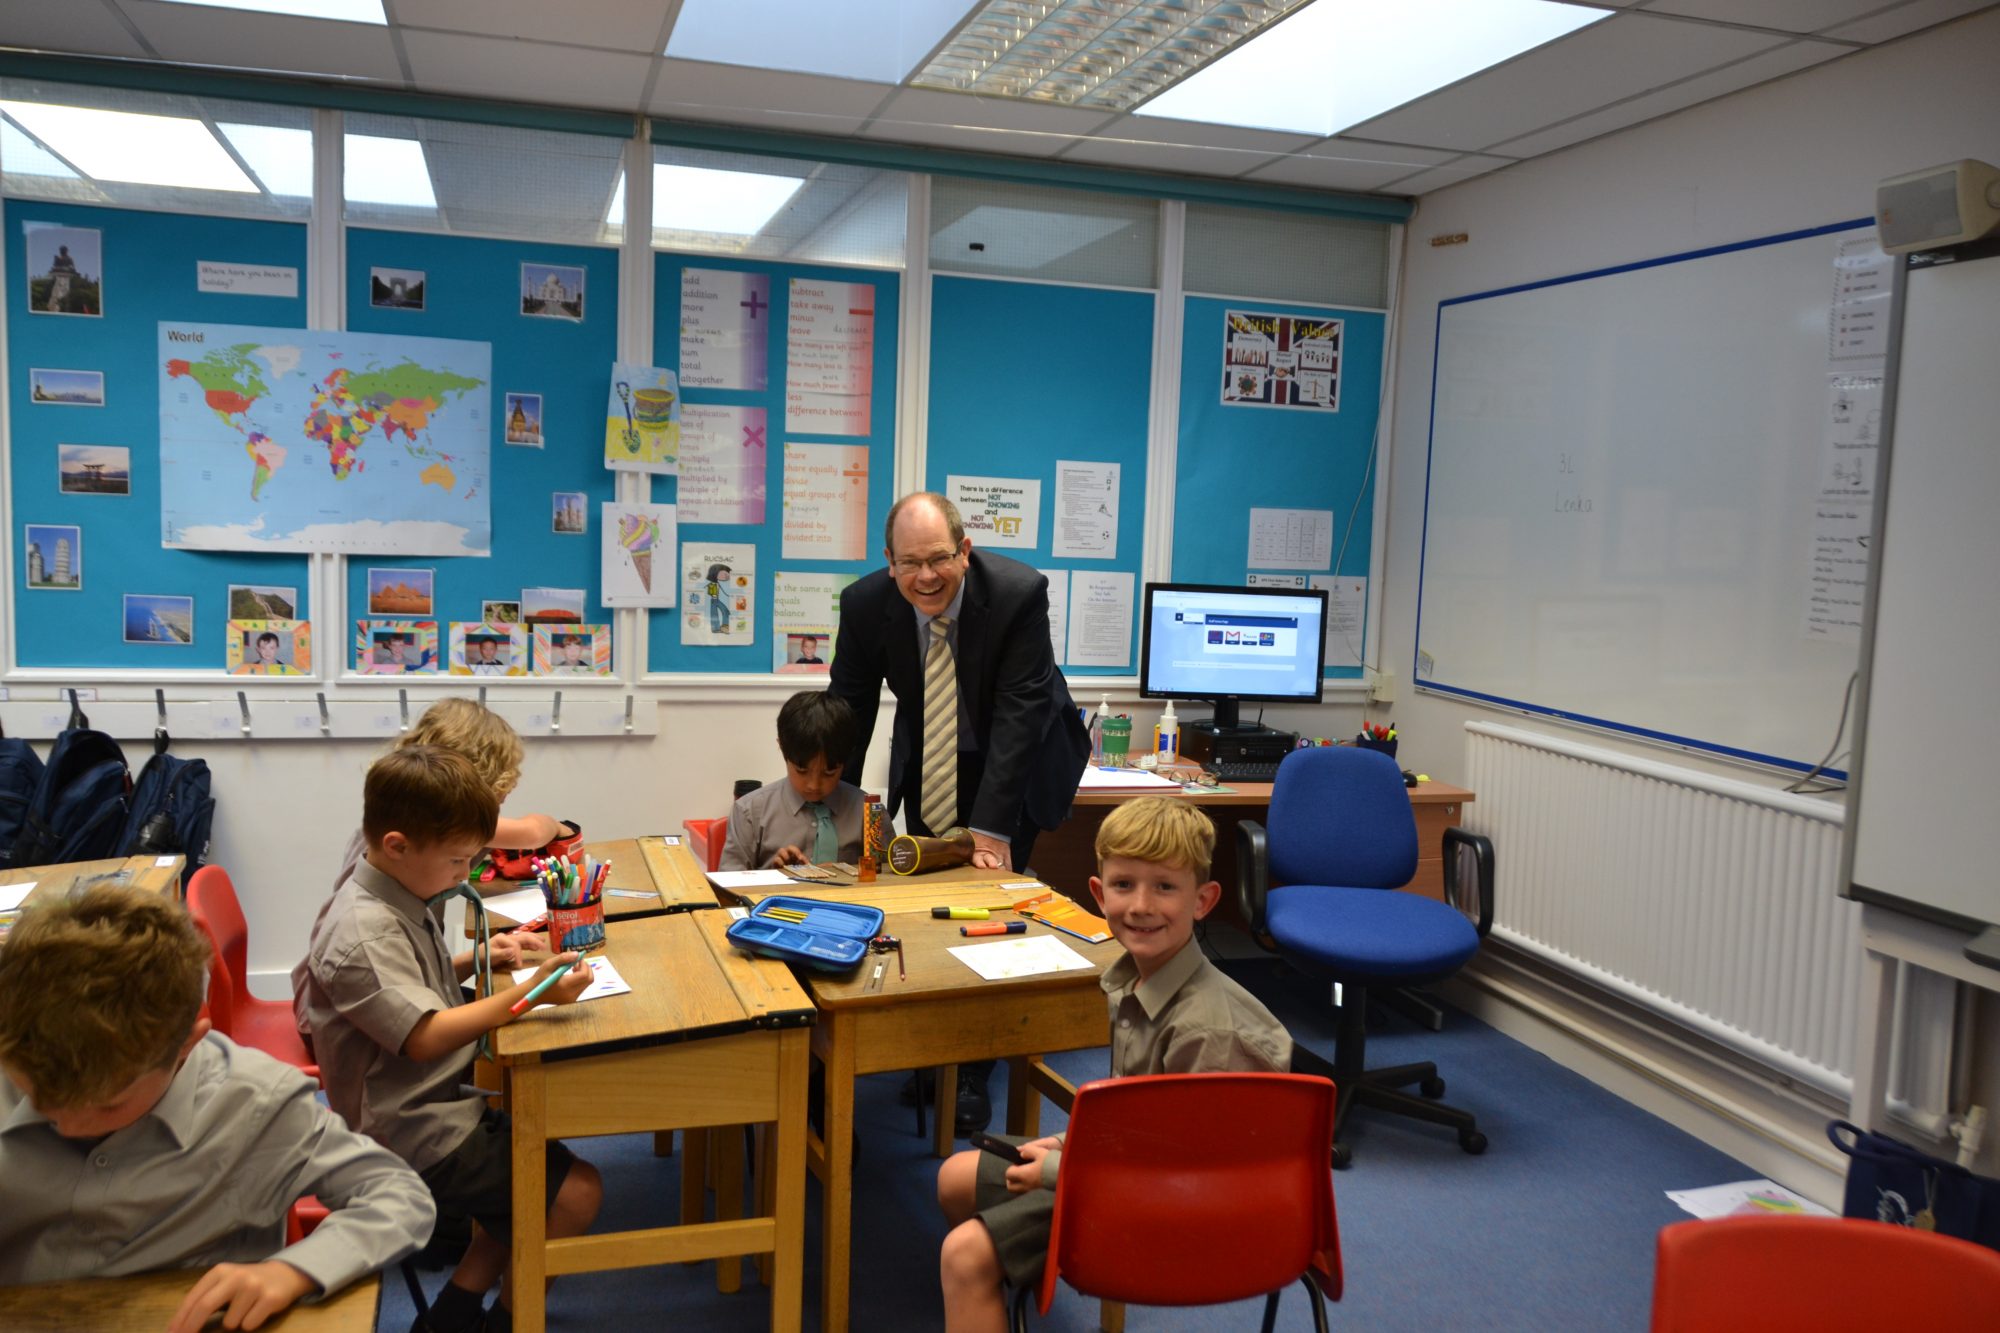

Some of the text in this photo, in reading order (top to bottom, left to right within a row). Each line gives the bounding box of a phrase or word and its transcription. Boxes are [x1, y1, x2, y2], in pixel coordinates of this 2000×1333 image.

[682, 275, 700, 285] add
[682, 289, 719, 300] addition
[791, 287, 825, 297] subtract
[682, 303, 704, 313] more
[790, 301, 835, 314] take away
[682, 315, 700, 326] plus
[790, 314, 815, 323] minus
[790, 325, 812, 336] leave
[1233, 317, 1336, 338] British Values
[167, 329, 205, 343] World
[681, 335, 705, 344] make
[681, 348, 698, 357] sum
[680, 361, 702, 371] total
[680, 373, 724, 385] altogether
[787, 391, 803, 401] less
[680, 408, 731, 419] multiplication
[787, 405, 864, 417] difference between
[784, 450, 807, 460] share
[784, 463, 839, 477] share equally
[784, 476, 809, 485] divide
[784, 490, 848, 502] equal groups of
[960, 493, 1002, 504] between NOT
[984, 508, 998, 516] and
[784, 520, 827, 532] divided by
[971, 514, 1023, 534] NOT YET
[784, 533, 833, 543] divided into
[704, 555, 735, 563] RUCSAC
[784, 583, 798, 593] the
[800, 585, 822, 593] same
[774, 596, 801, 607] equals
[774, 608, 806, 618] balance
[556, 910, 578, 920] Berol
